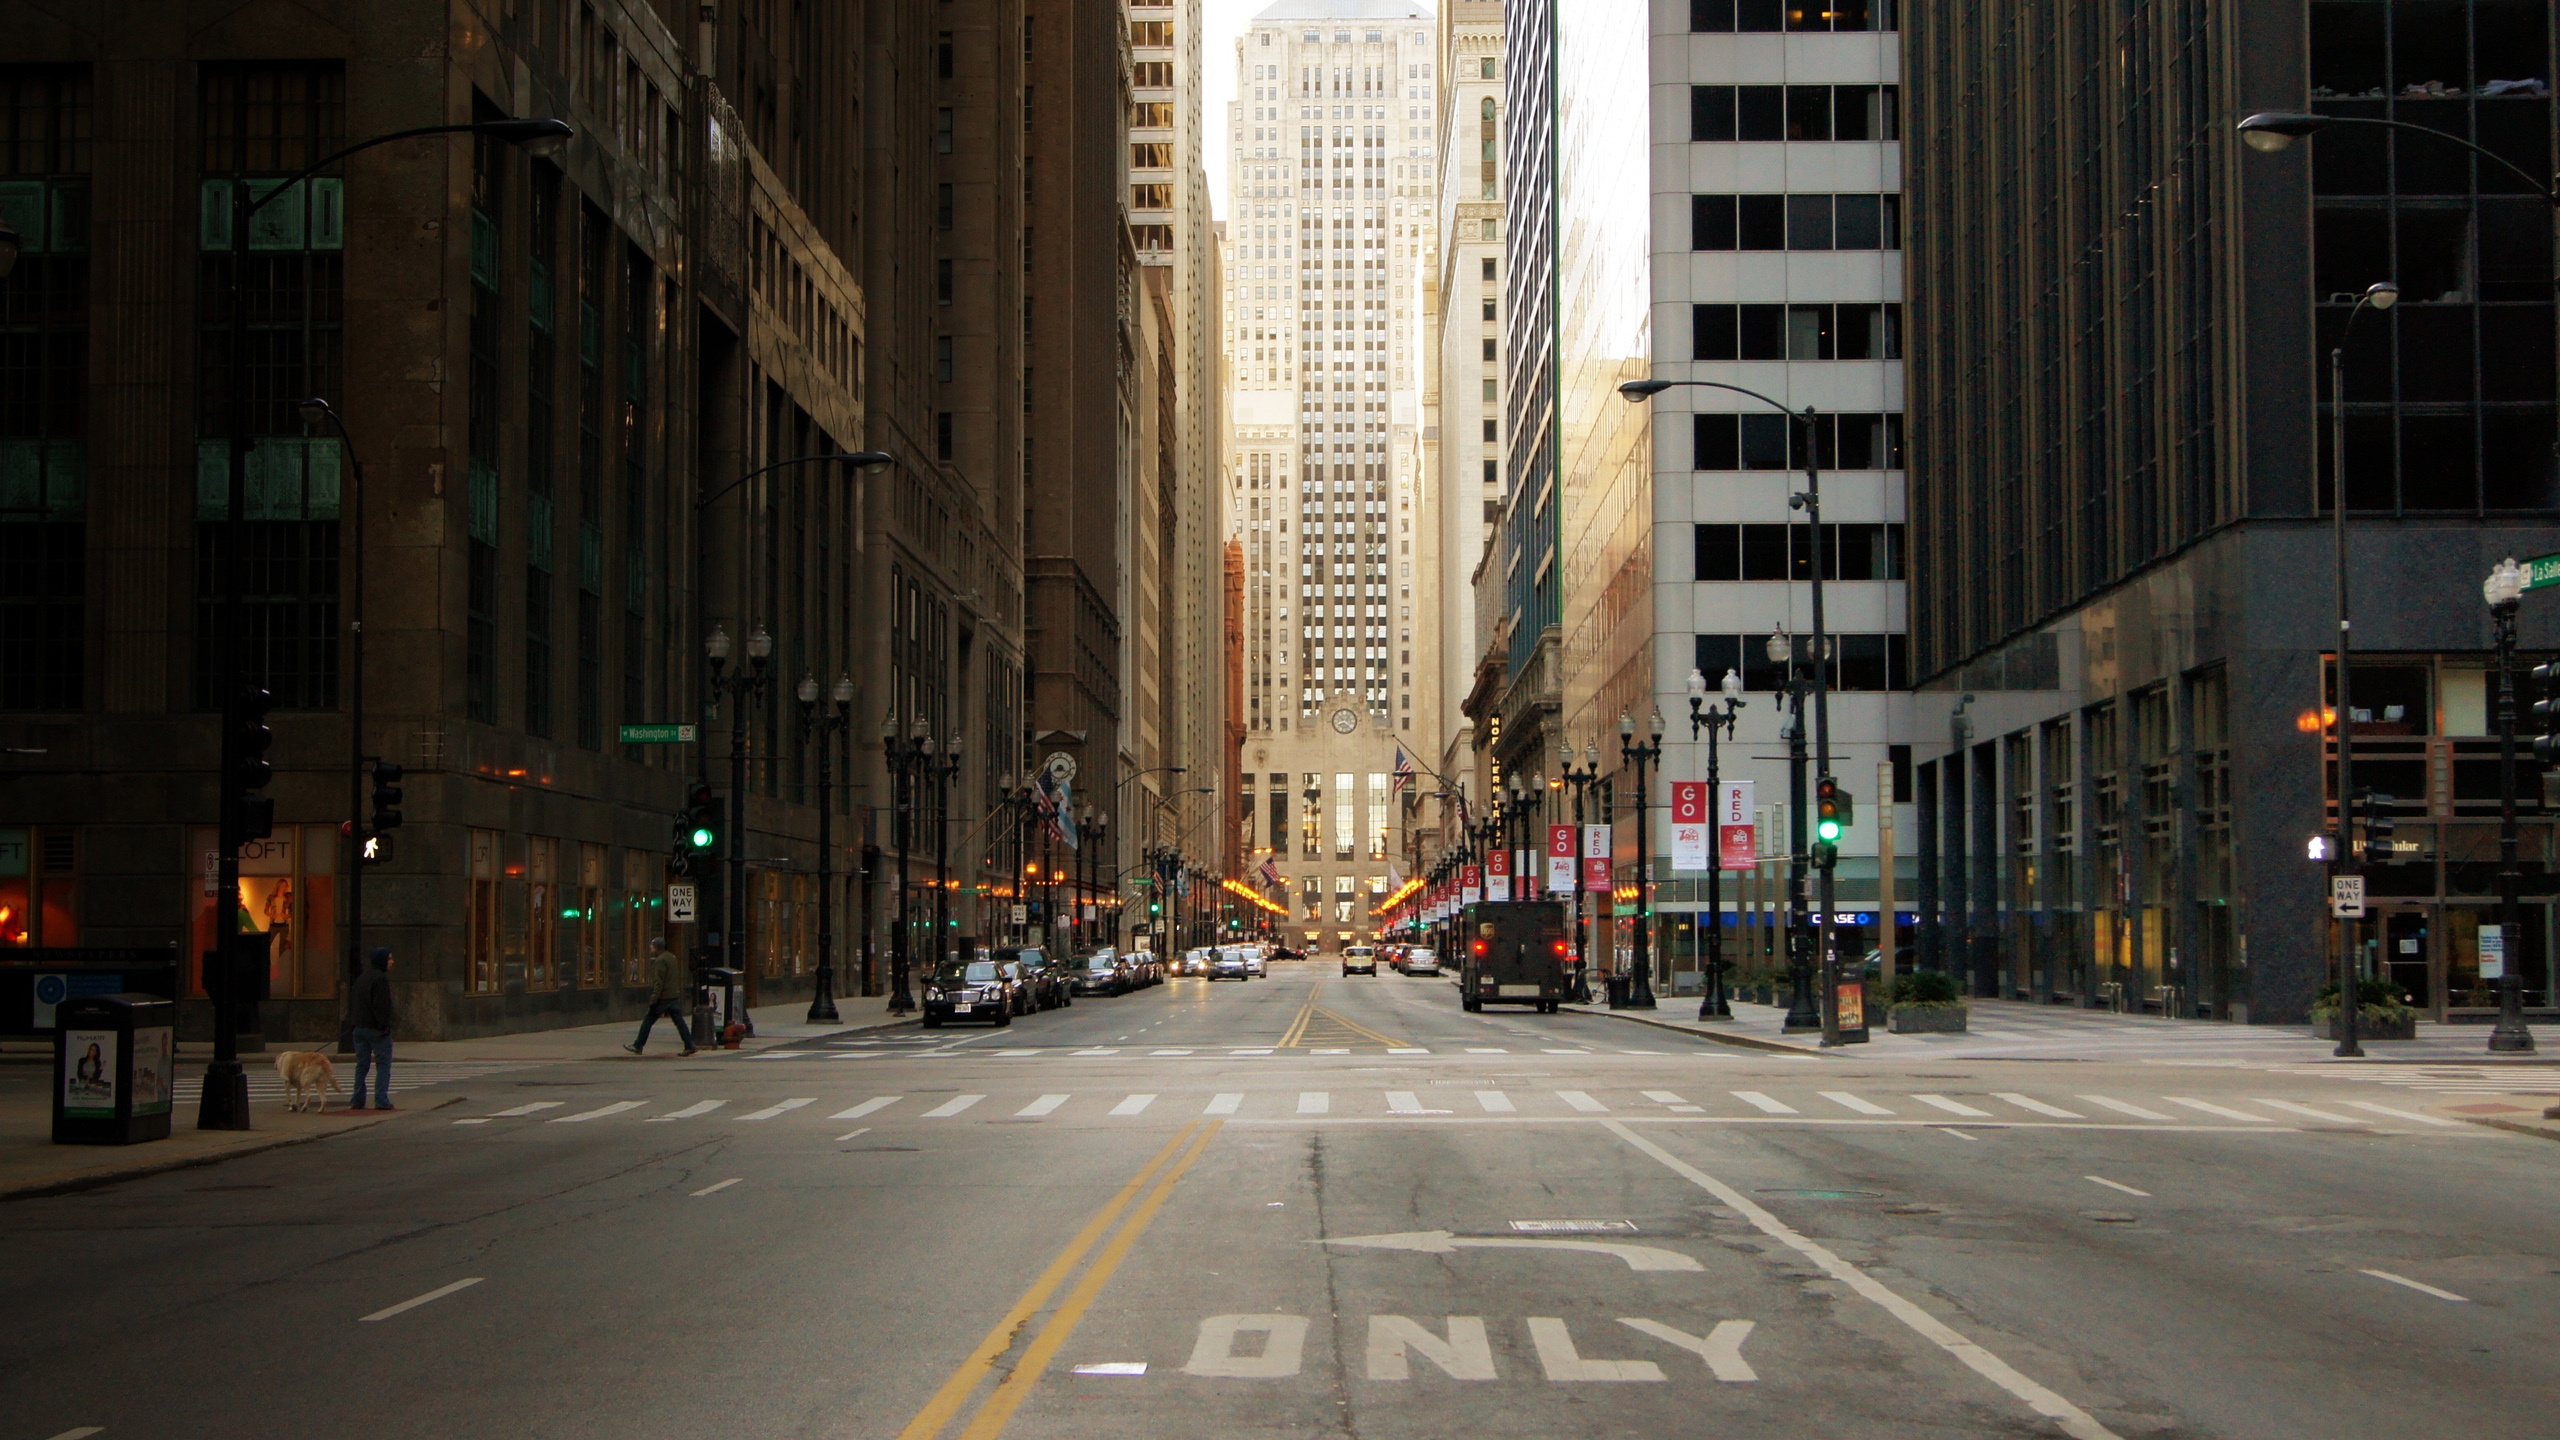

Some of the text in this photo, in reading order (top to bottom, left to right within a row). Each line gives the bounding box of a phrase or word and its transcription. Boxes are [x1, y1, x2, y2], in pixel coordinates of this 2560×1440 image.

[628, 727, 669, 742] Washington
[1491, 717, 1500, 794] NORERN
[1681, 787, 1696, 817] GO
[1732, 789, 1742, 822] RED
[1556, 829, 1567, 852] GO
[1593, 830, 1601, 855] RED
[2391, 840, 2419, 852] lular
[1494, 854, 1502, 872] GO
[1467, 869, 1474, 884] GO
[672, 887, 692, 897] ONE
[1454, 881, 1460, 893] GO
[2337, 879, 2359, 890] ONE
[672, 898, 692, 907] WAY
[2336, 891, 2360, 901] WAY
[1811, 913, 1856, 924] CASE
[1181, 1313, 1759, 1382] ONLY
